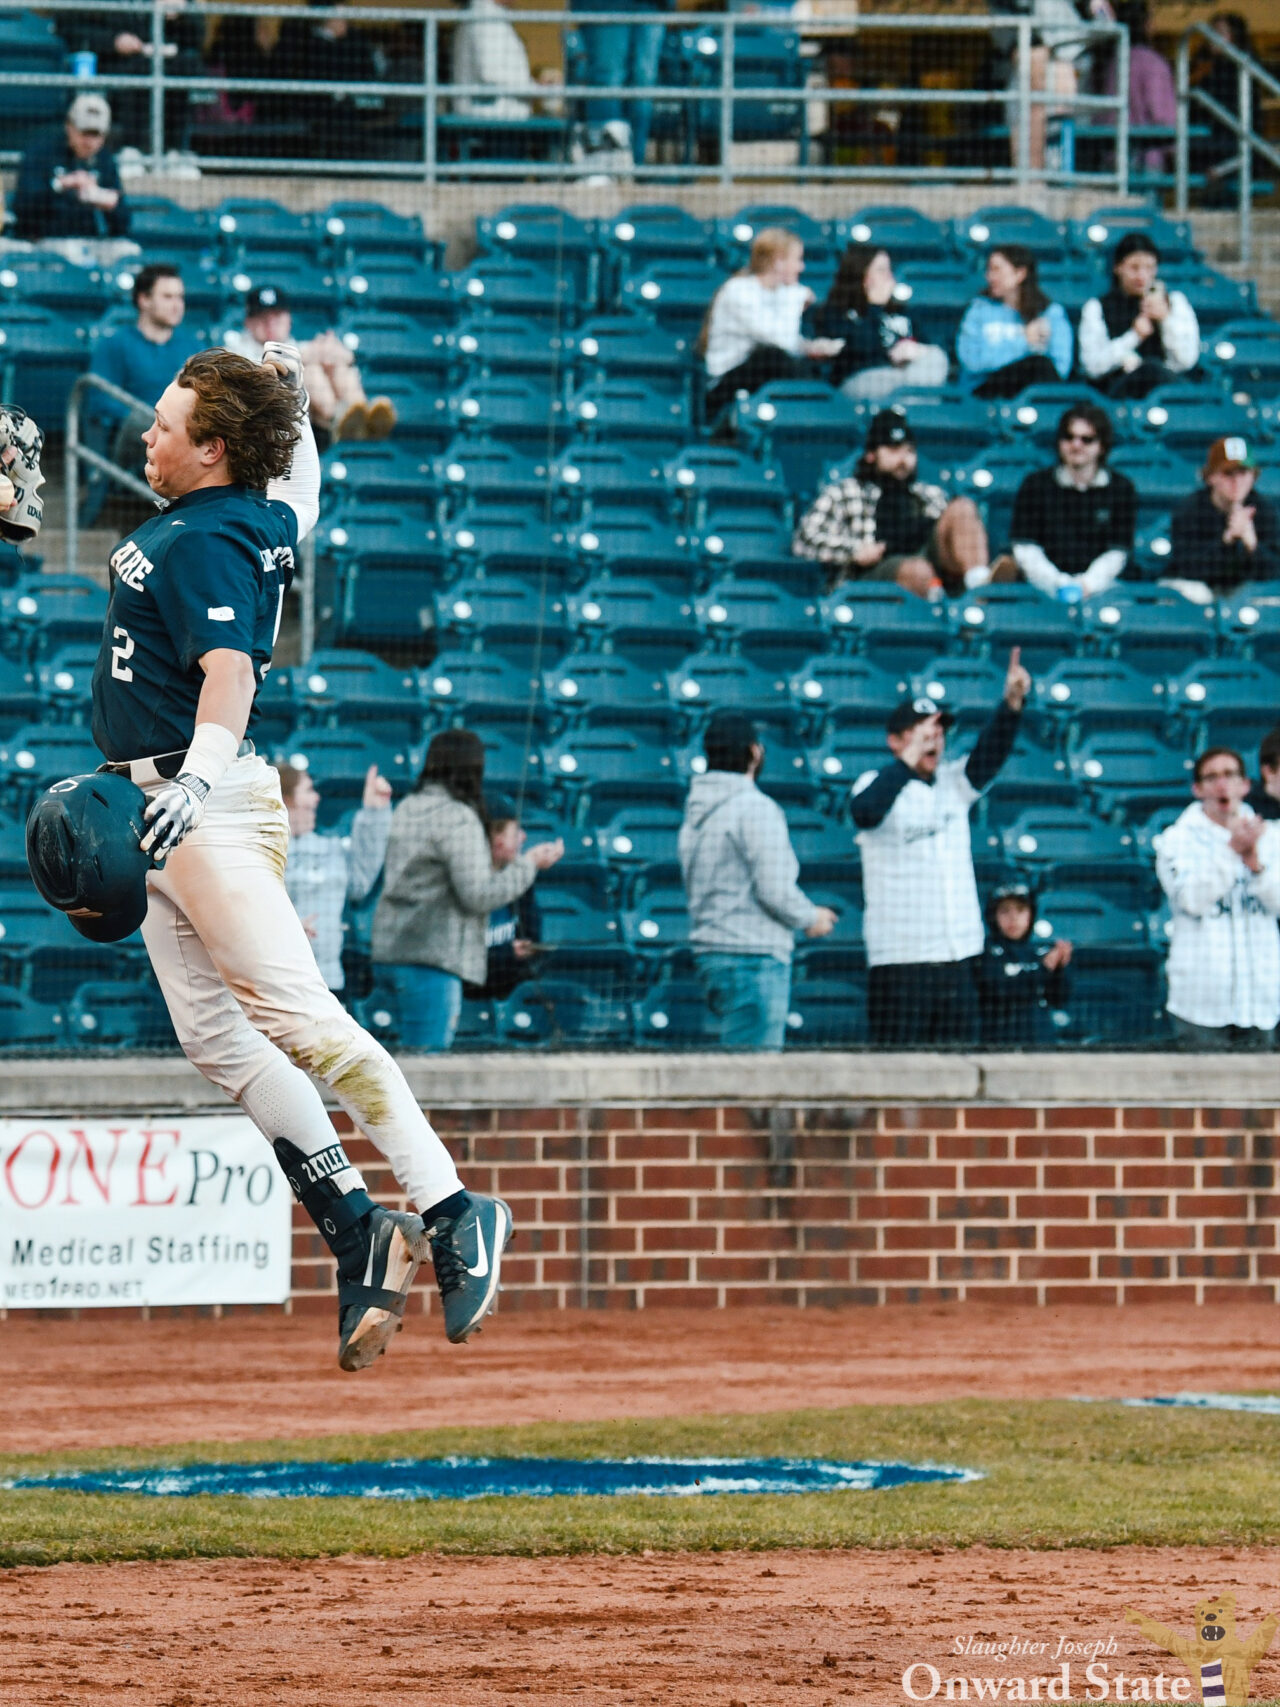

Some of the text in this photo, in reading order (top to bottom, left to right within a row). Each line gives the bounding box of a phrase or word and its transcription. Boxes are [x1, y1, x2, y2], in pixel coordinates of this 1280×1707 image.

[110, 540, 154, 593] ARE
[111, 625, 135, 683] 2
[11, 1237, 135, 1267] Medical
[147, 1234, 270, 1270] Staffing
